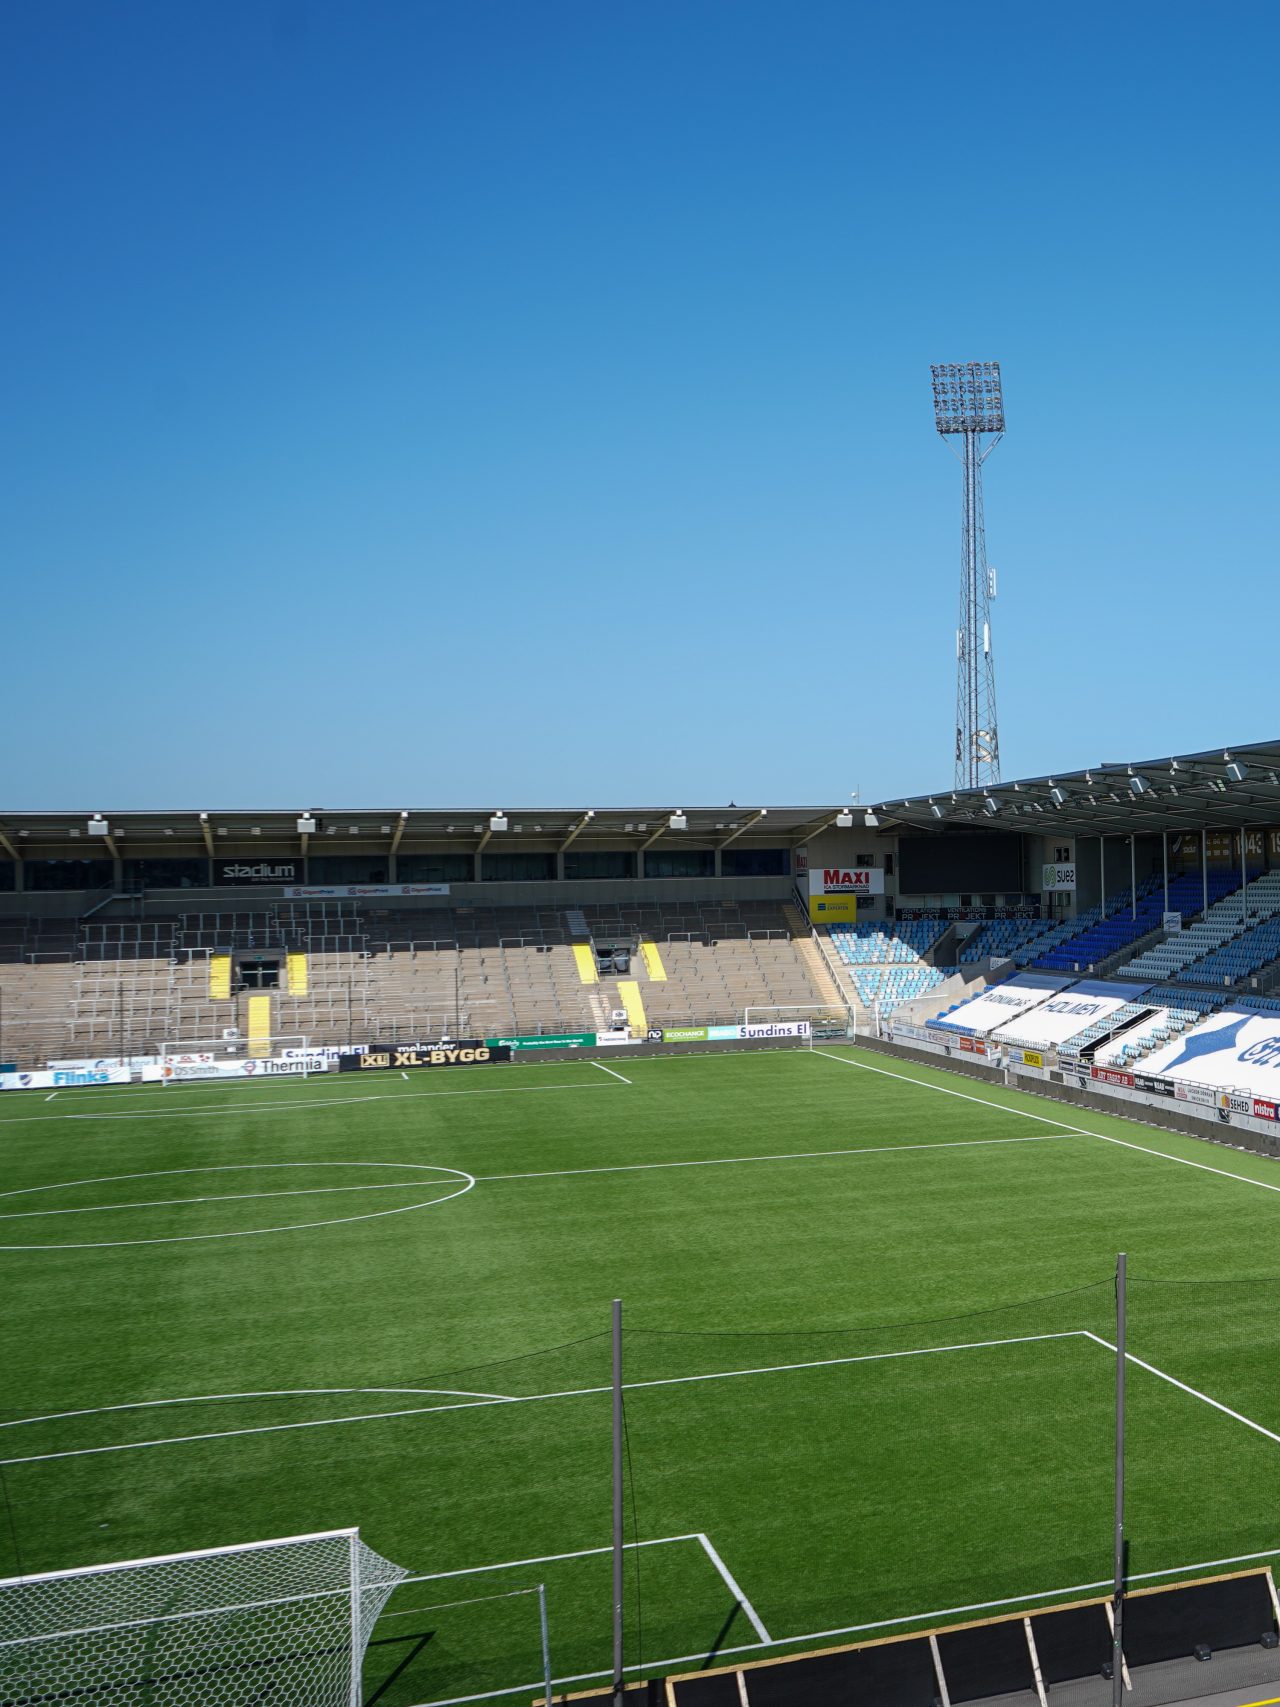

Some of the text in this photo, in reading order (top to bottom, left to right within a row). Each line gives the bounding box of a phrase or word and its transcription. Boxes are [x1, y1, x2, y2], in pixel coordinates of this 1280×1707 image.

[223, 863, 295, 878] stadium
[740, 1024, 792, 1038] Sundins
[797, 1023, 807, 1034] El
[394, 1047, 490, 1066] XL-BYGG
[261, 1059, 322, 1073] Thermia
[53, 1071, 110, 1085] Flinks
[1230, 1098, 1249, 1113] SEHED
